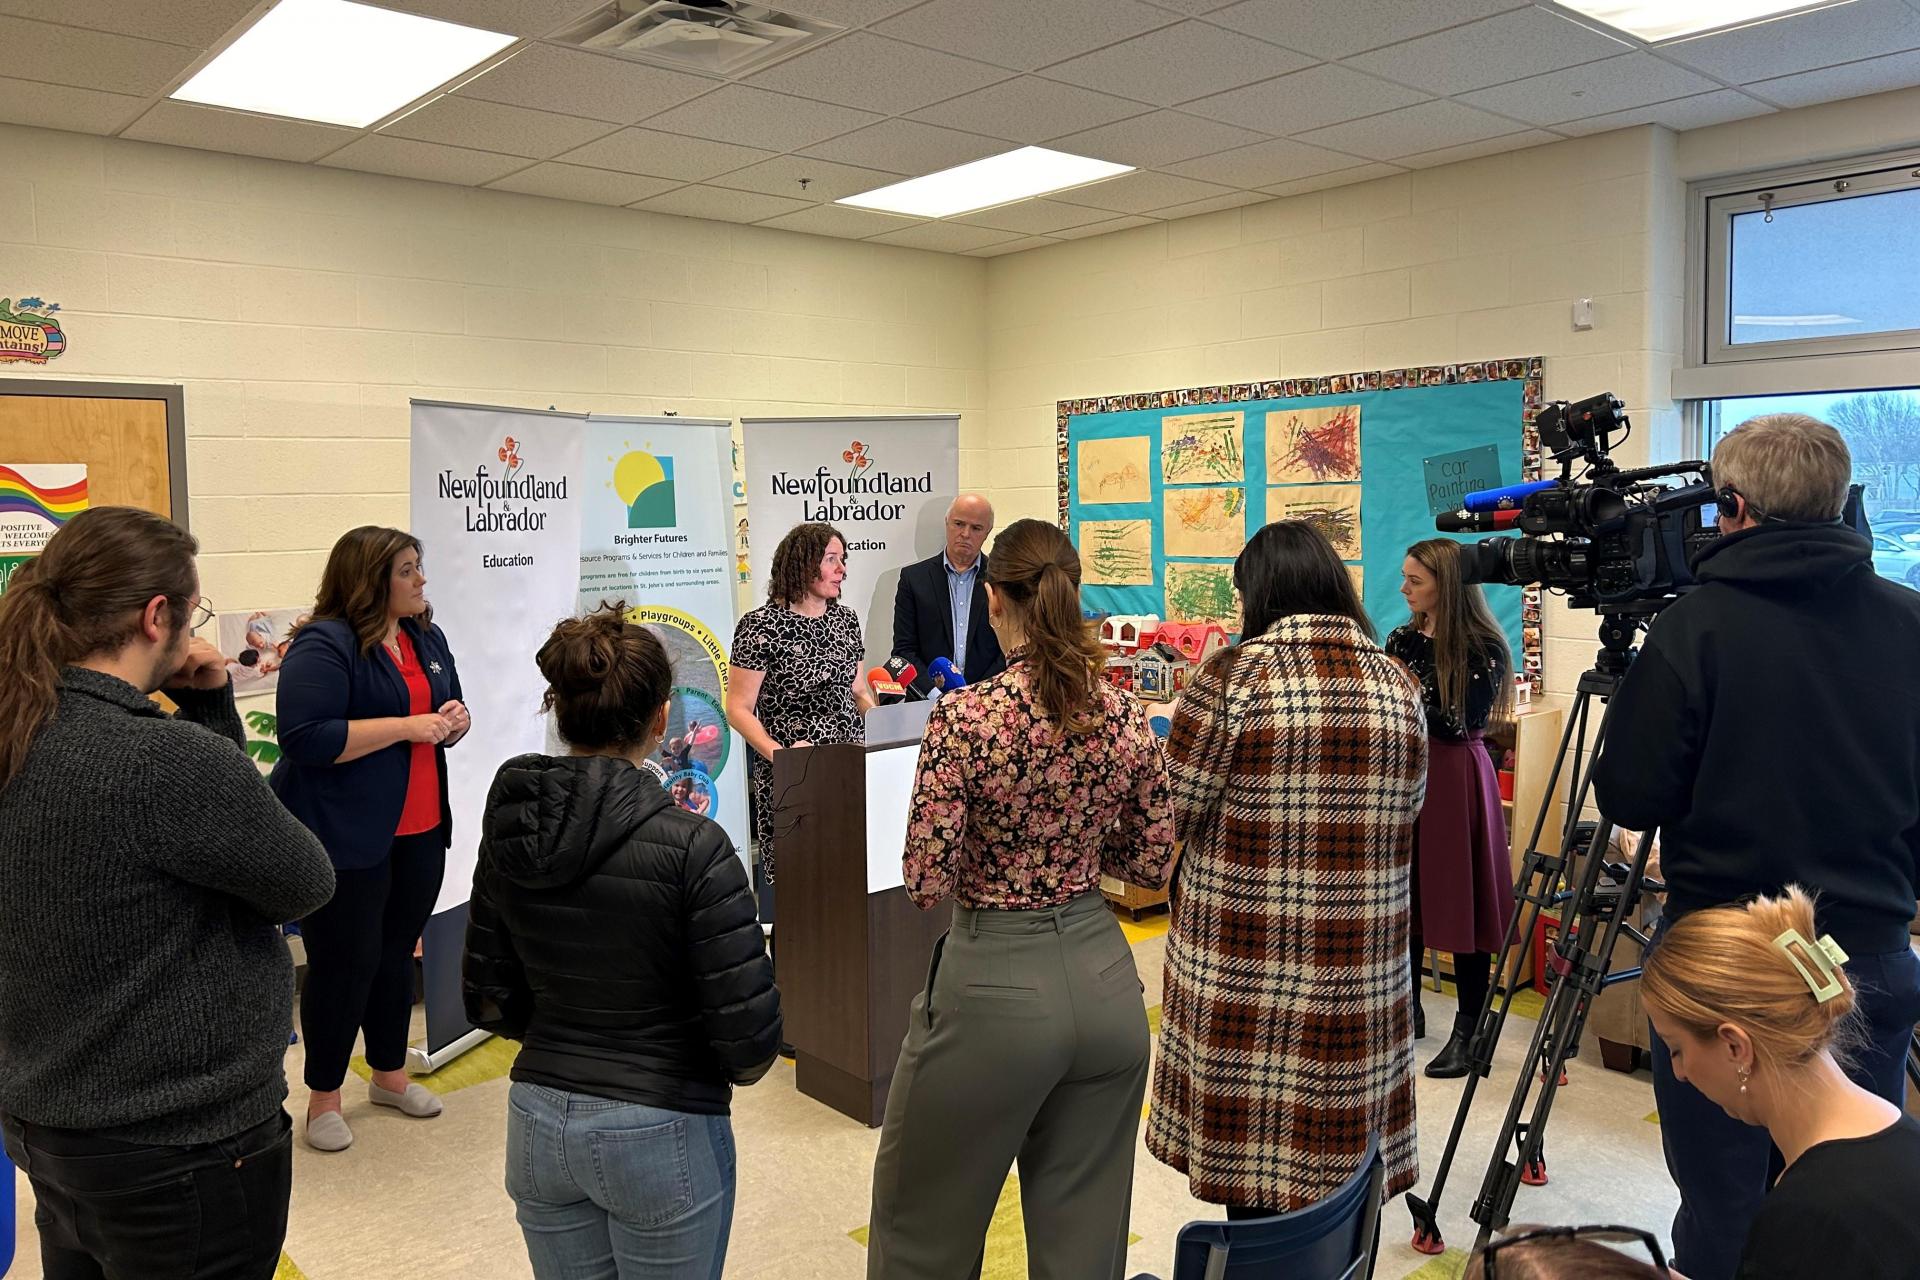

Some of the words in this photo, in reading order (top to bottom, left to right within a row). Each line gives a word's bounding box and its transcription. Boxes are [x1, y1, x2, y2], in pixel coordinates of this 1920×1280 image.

[0, 326, 39, 340] MOVE
[438, 465, 568, 508] Newfoundland
[771, 466, 932, 501] Newfoundland
[466, 502, 546, 532] Labrador
[804, 497, 905, 521] Labrador
[614, 535, 652, 546] Brighter
[654, 534, 688, 543] Futures
[847, 539, 886, 550] cation
[483, 553, 533, 568] Education
[603, 554, 630, 562] Programs
[639, 552, 662, 560] Services
[663, 551, 671, 559] for
[640, 610, 696, 632] Playgroups
[702, 634, 721, 660] Little
[686, 687, 708, 699] Parent
[711, 699, 729, 733] Education
[643, 760, 664, 778] upport
[684, 771, 698, 779] Baby
[698, 774, 710, 785] Club
